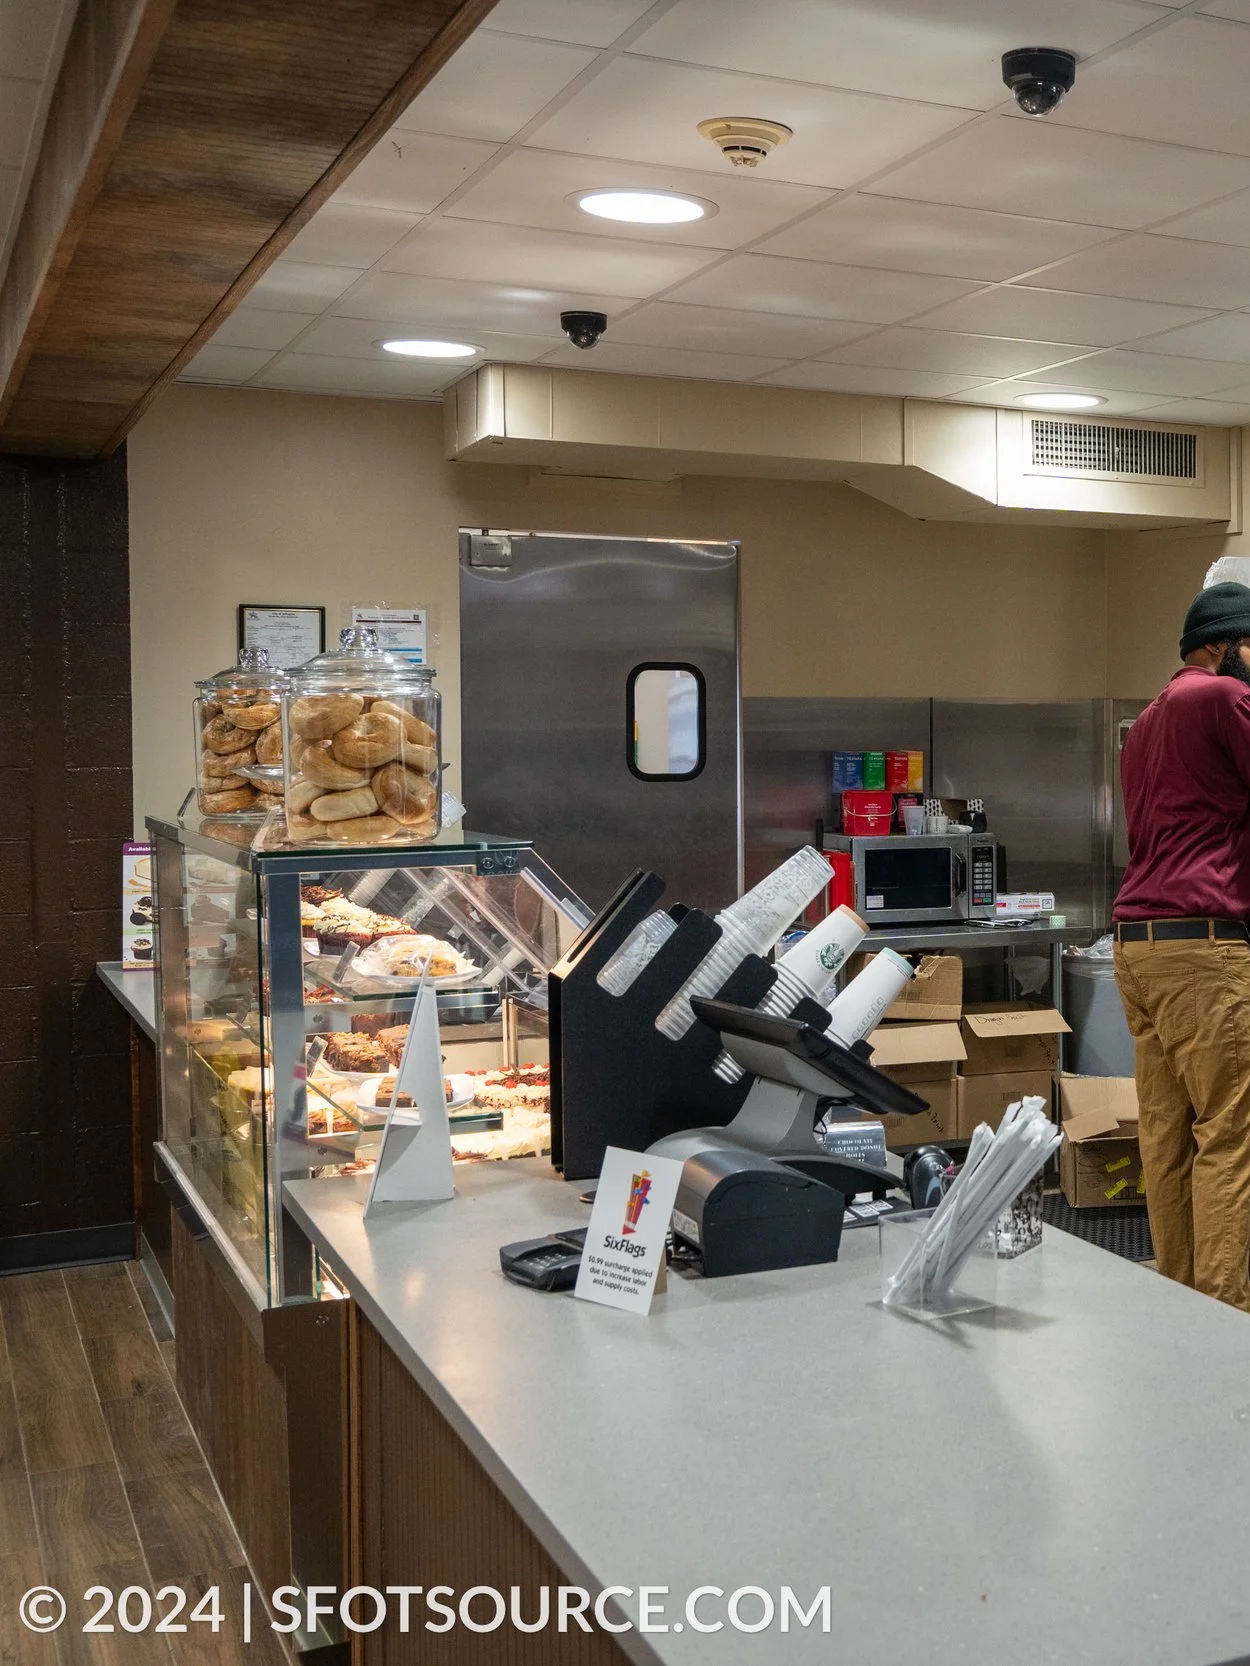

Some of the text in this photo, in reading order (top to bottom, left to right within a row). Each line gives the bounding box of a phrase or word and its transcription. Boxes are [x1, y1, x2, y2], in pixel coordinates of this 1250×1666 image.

[588, 1255, 653, 1278] $0.99 surcharge applied
[589, 1266, 647, 1286] due to increase labor
[593, 1277, 639, 1295] and supply costs.
